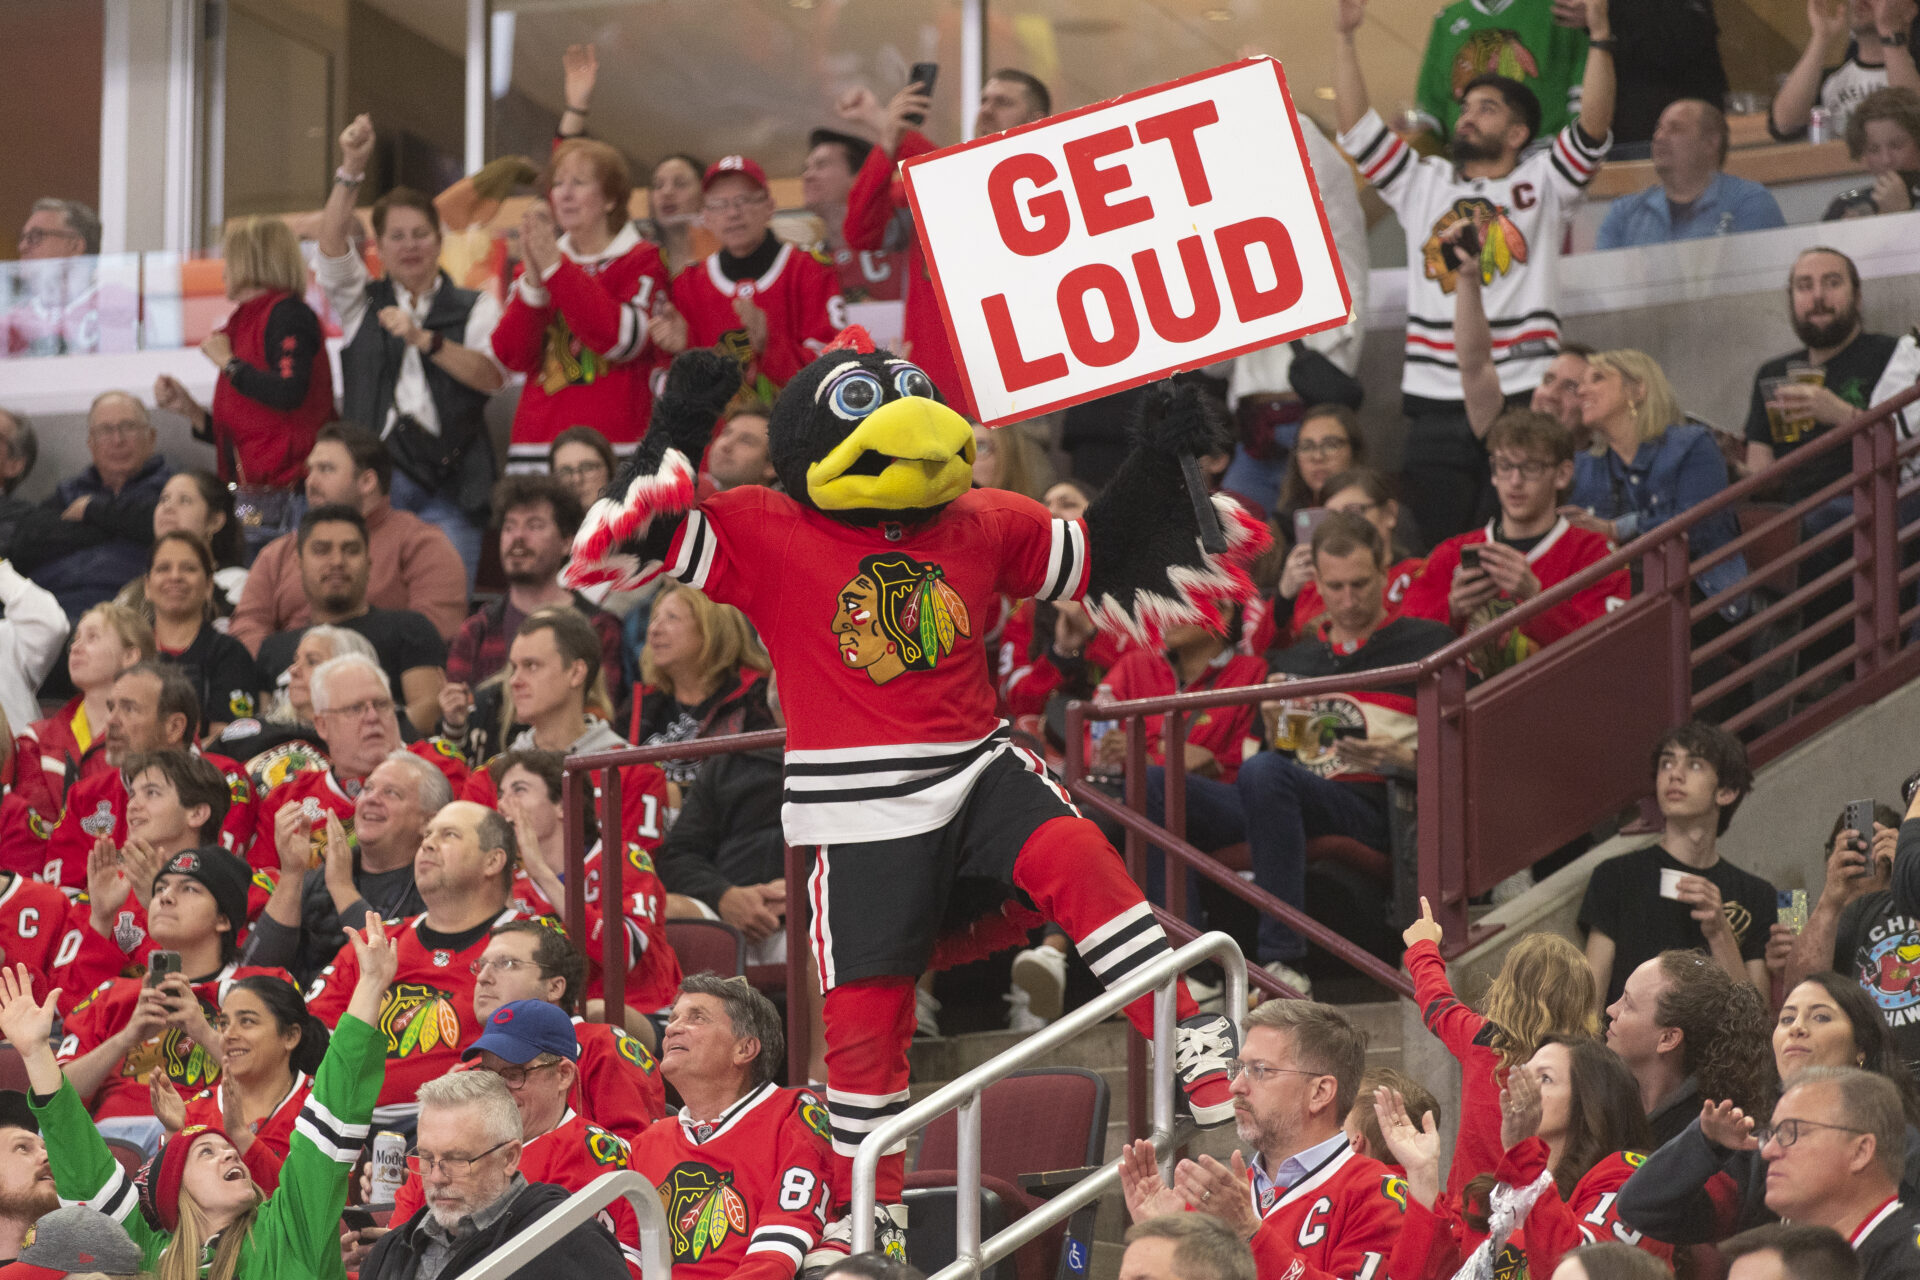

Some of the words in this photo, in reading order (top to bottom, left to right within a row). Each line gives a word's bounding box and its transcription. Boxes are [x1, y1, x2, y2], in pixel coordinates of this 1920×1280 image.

[987, 99, 1219, 257] GET
[1512, 183, 1536, 210] C
[858, 250, 892, 282] C
[981, 216, 1304, 393] LOUD
[18, 907, 40, 939] C
[779, 1166, 831, 1226] 81
[1298, 1196, 1333, 1249] C
